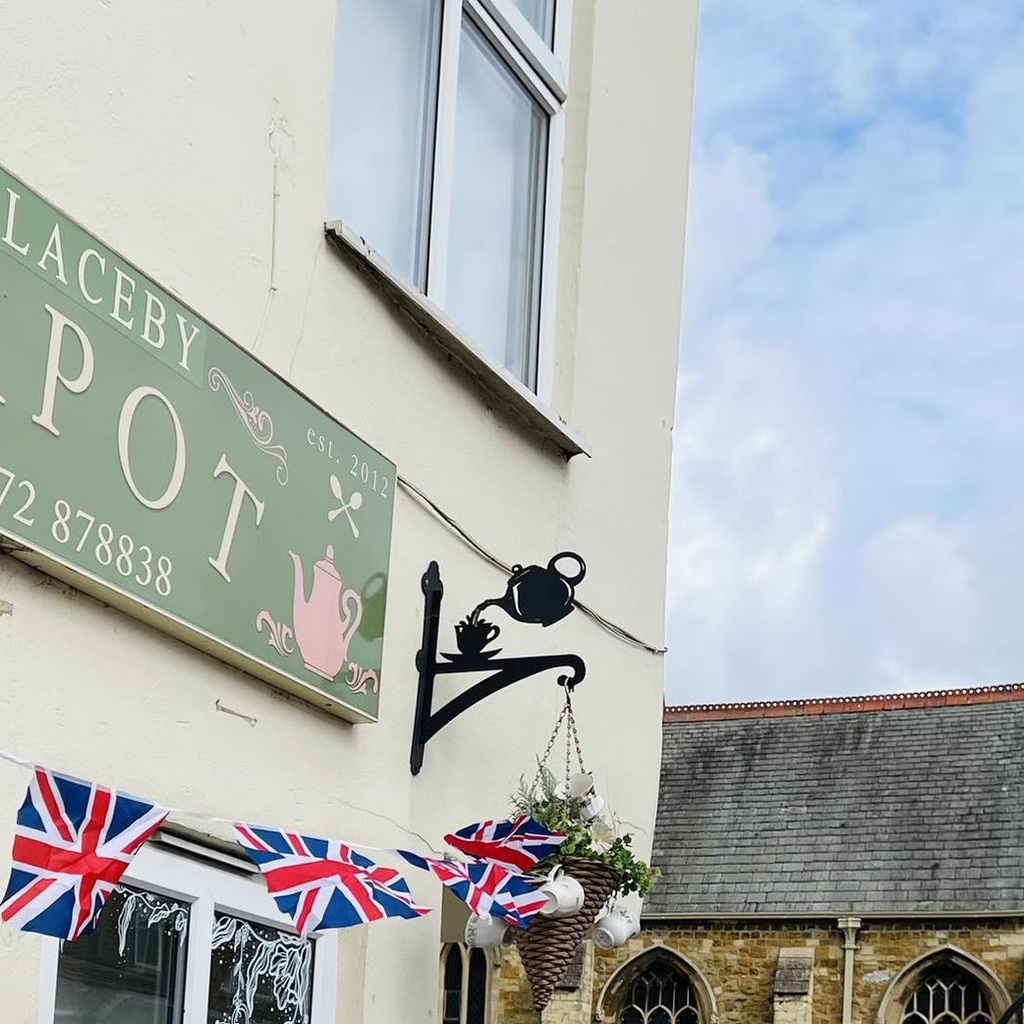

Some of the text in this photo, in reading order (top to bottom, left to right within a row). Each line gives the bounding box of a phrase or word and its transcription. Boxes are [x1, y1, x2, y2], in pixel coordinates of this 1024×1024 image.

[2, 188, 201, 373] LACEBY
[307, 427, 389, 499] est. 2012
[51, 500, 173, 597] 878838
